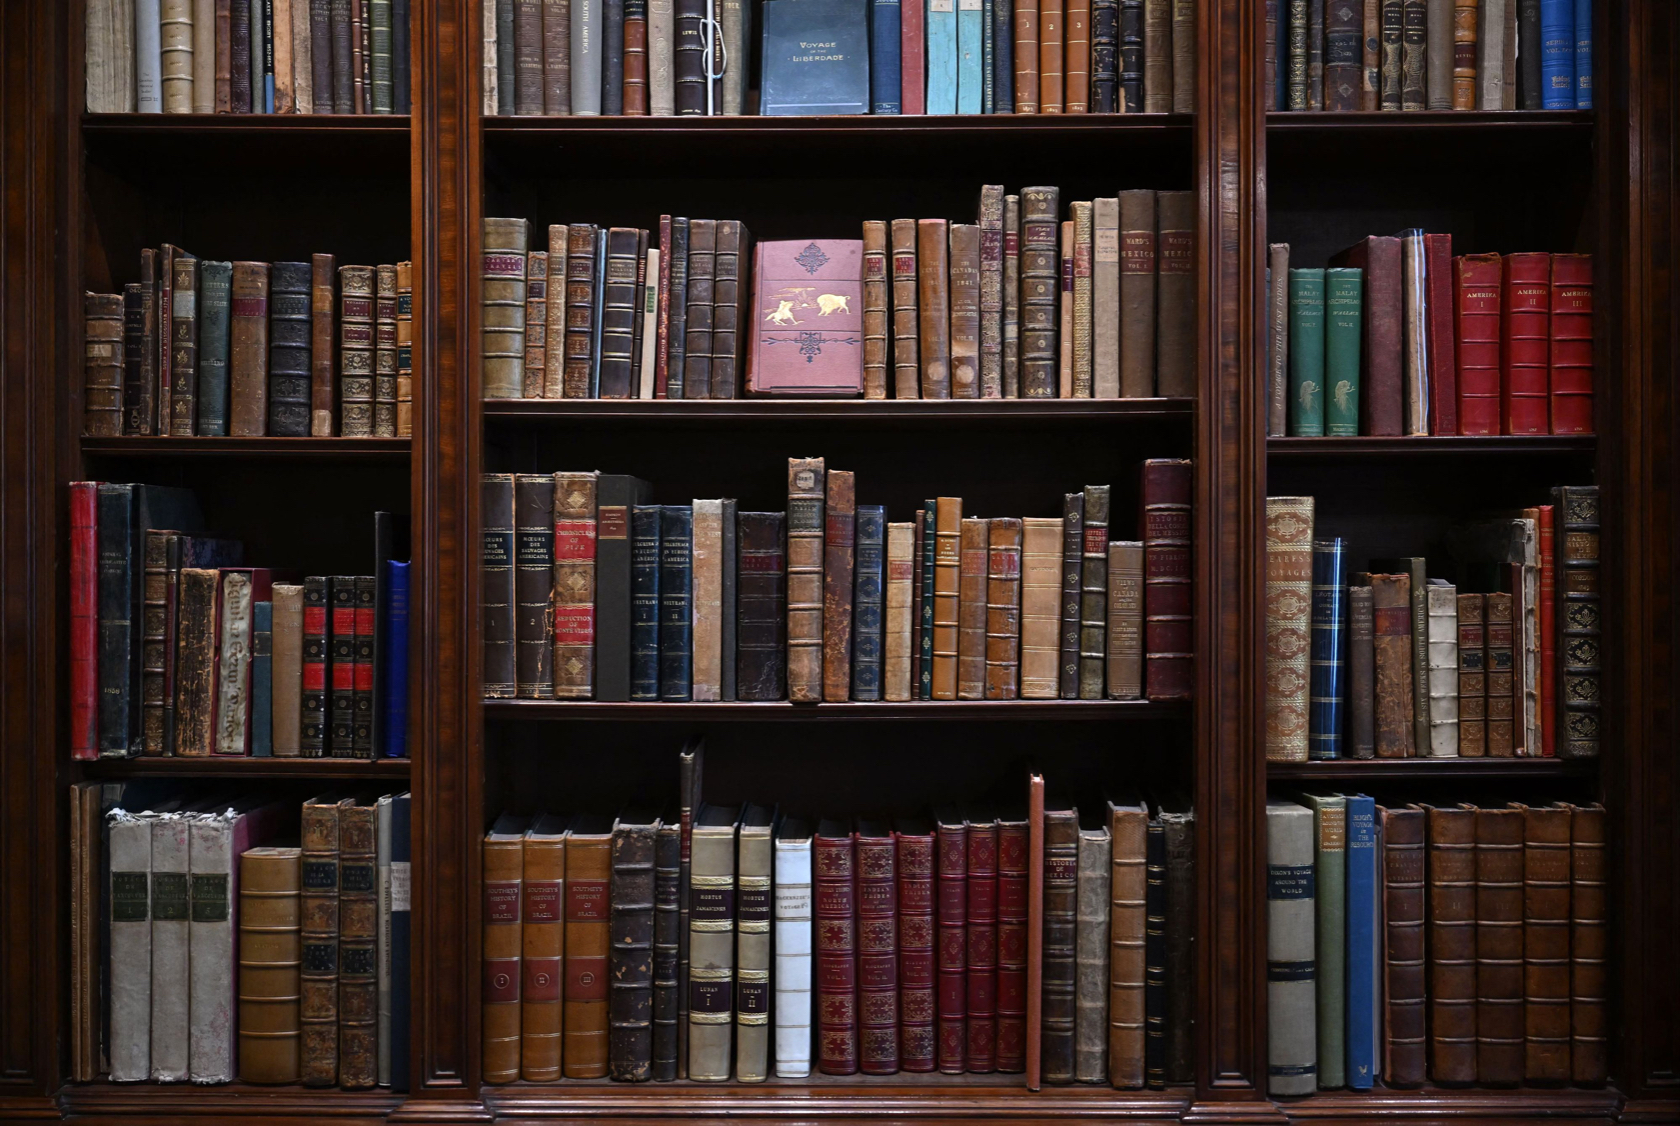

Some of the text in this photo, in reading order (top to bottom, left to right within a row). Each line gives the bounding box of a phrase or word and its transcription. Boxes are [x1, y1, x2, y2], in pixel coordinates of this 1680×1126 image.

[986, 53, 992, 63] ON
[1277, 355, 1283, 366] TO
[1417, 604, 1425, 632] AMERICA
